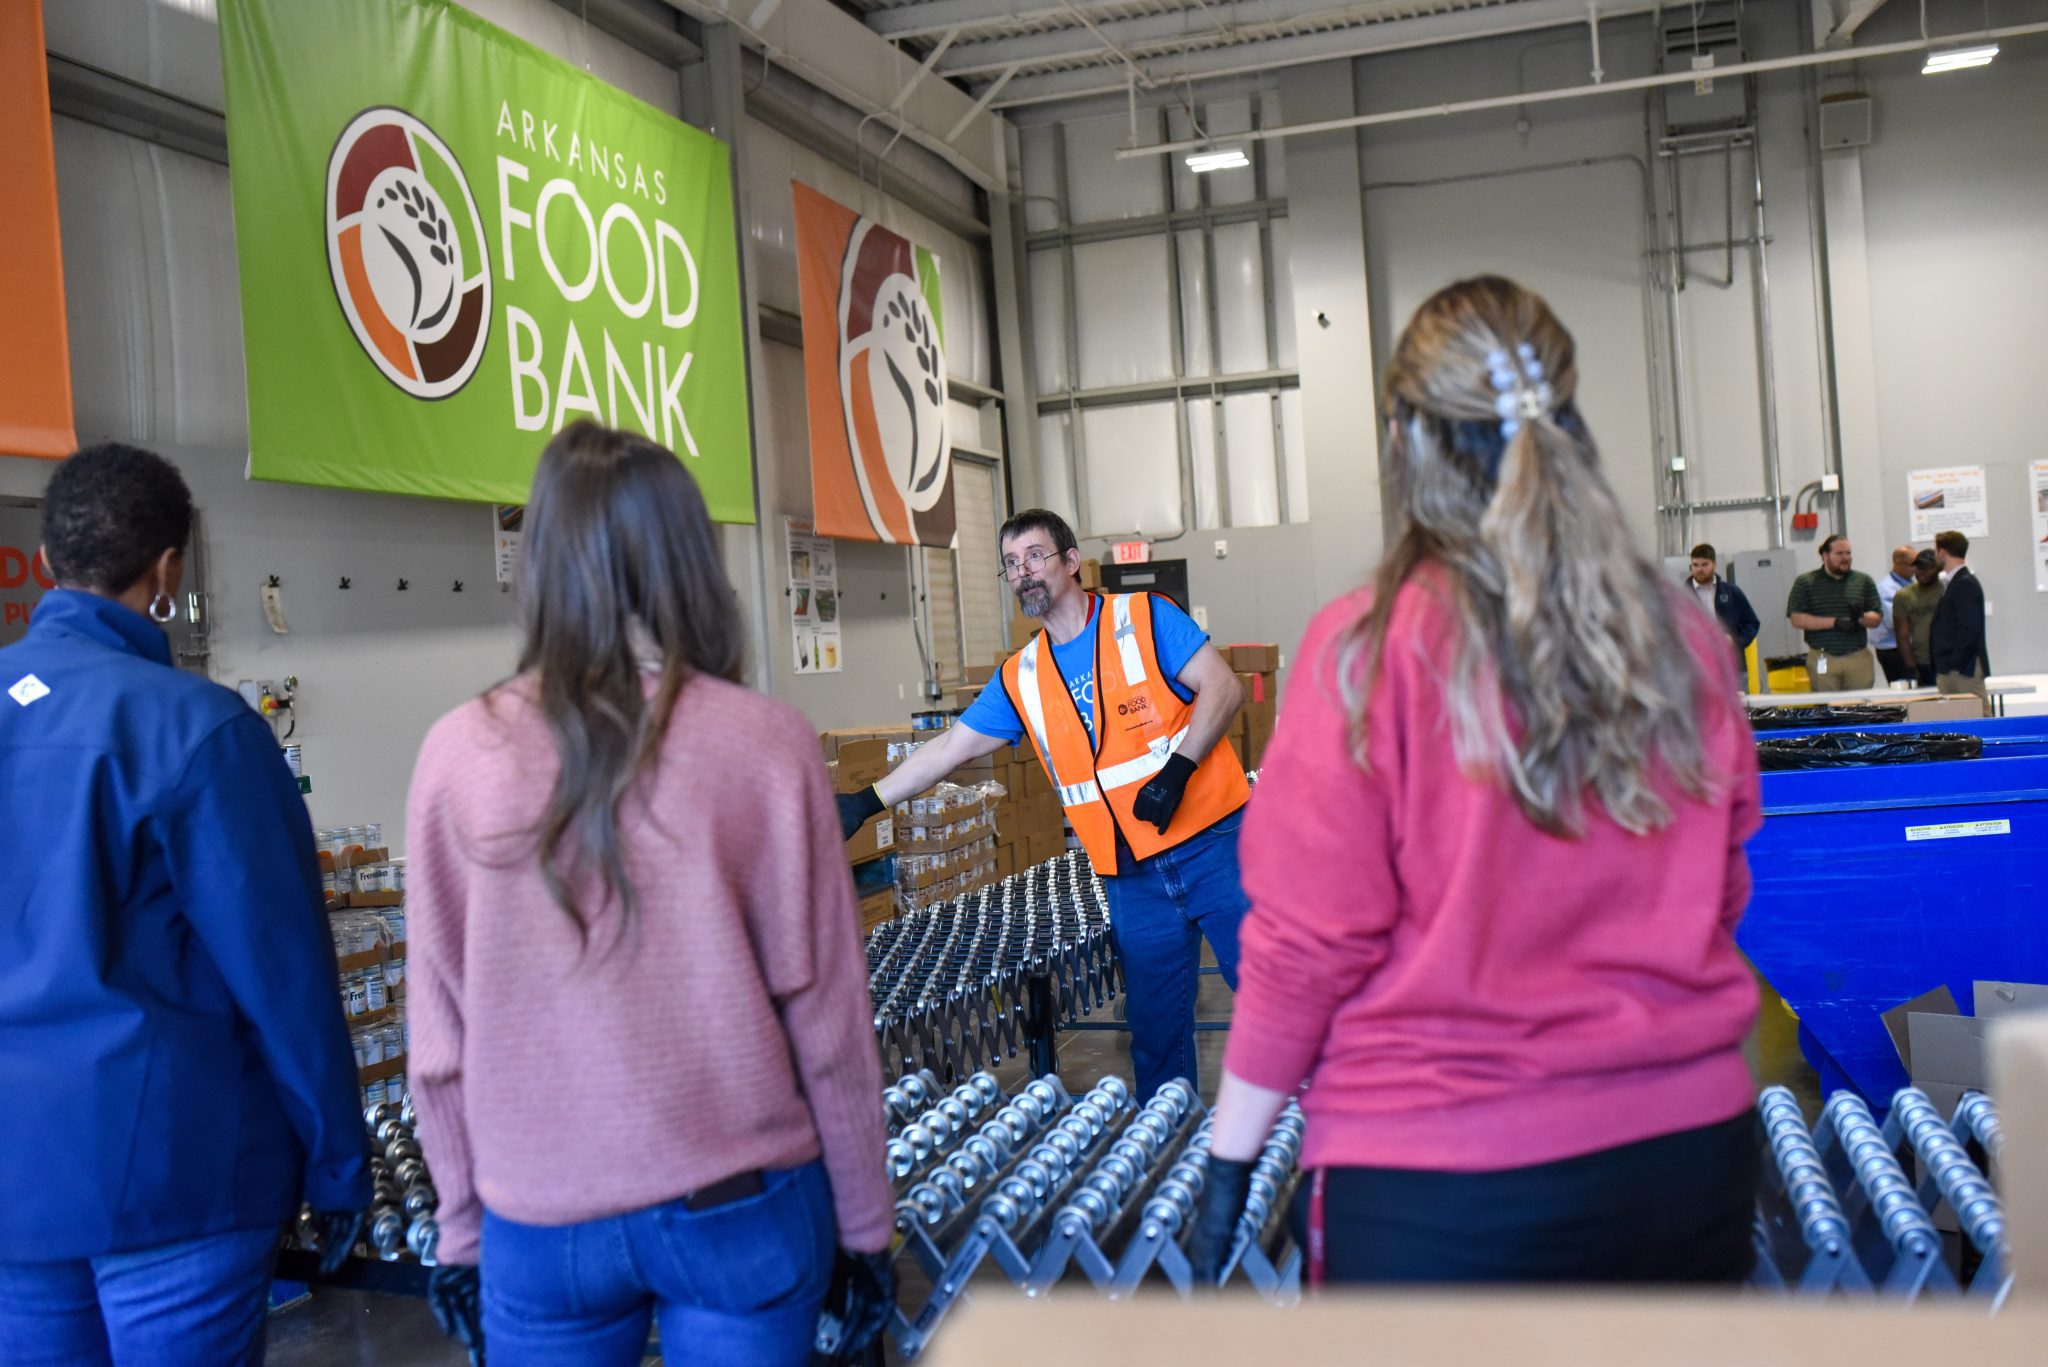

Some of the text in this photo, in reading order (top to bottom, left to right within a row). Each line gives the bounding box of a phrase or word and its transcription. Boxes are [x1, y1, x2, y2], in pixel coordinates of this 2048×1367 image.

[497, 99, 666, 205] ARKANSAS
[497, 155, 699, 329] FOOD
[506, 305, 700, 458] BANK
[1120, 541, 1141, 561] EXIT
[1070, 668, 1093, 688] ARKA
[1127, 696, 1146, 708] FOOD
[1130, 703, 1148, 714] BANK
